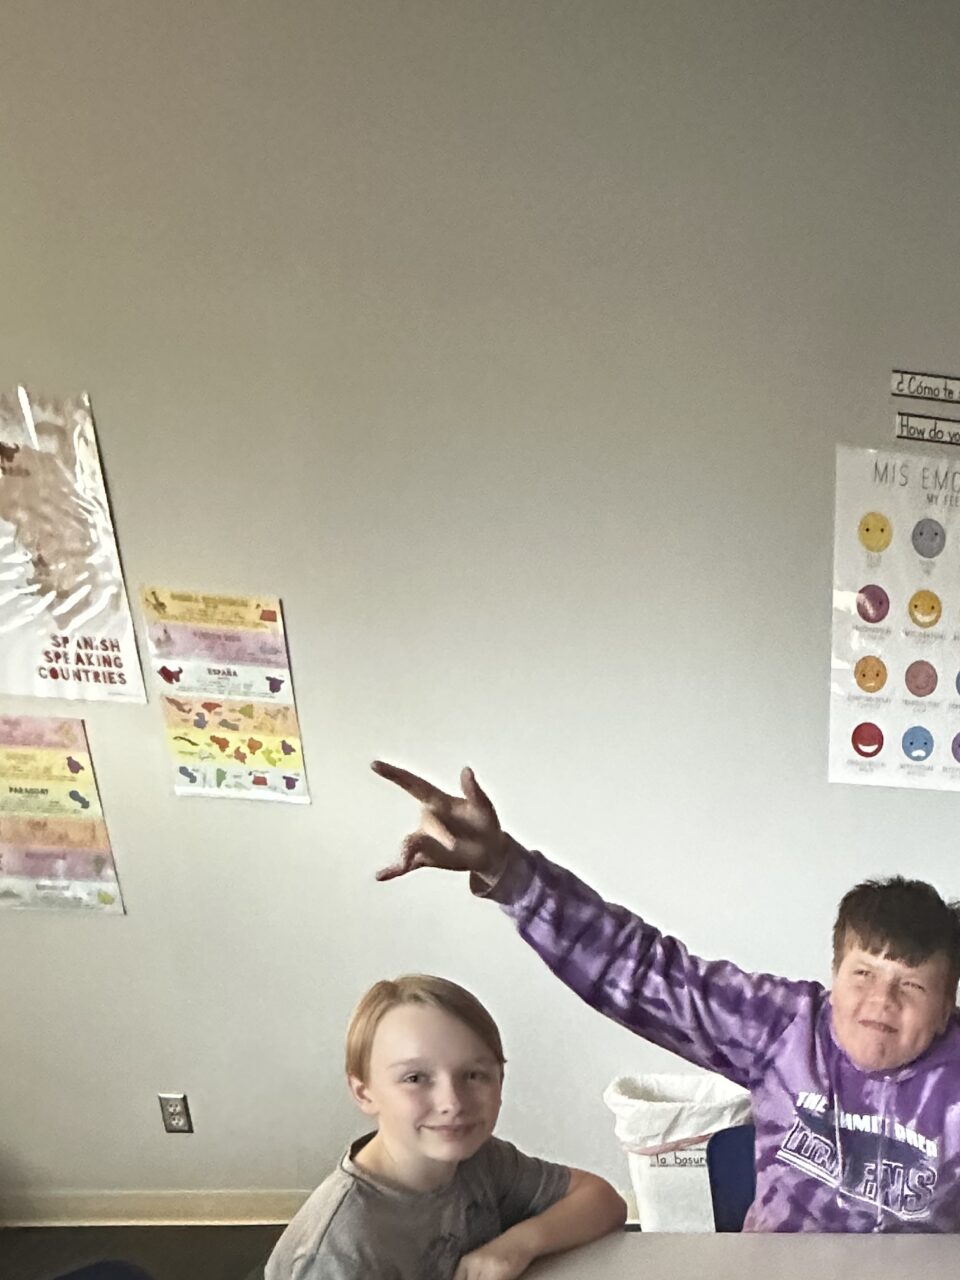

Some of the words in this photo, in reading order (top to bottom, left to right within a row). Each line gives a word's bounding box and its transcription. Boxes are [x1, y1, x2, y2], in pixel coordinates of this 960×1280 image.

[943, 380, 954, 400] te
[900, 415, 926, 437] How
[929, 420, 944, 440] do
[873, 461, 908, 487] MIS
[926, 493, 939, 504] MY
[43, 650, 124, 669] SPEAKING
[37, 666, 127, 685] COUNTRIES
[207, 667, 238, 678] ESPAÑA
[656, 1154, 666, 1165] la
[674, 1152, 708, 1165] basur
